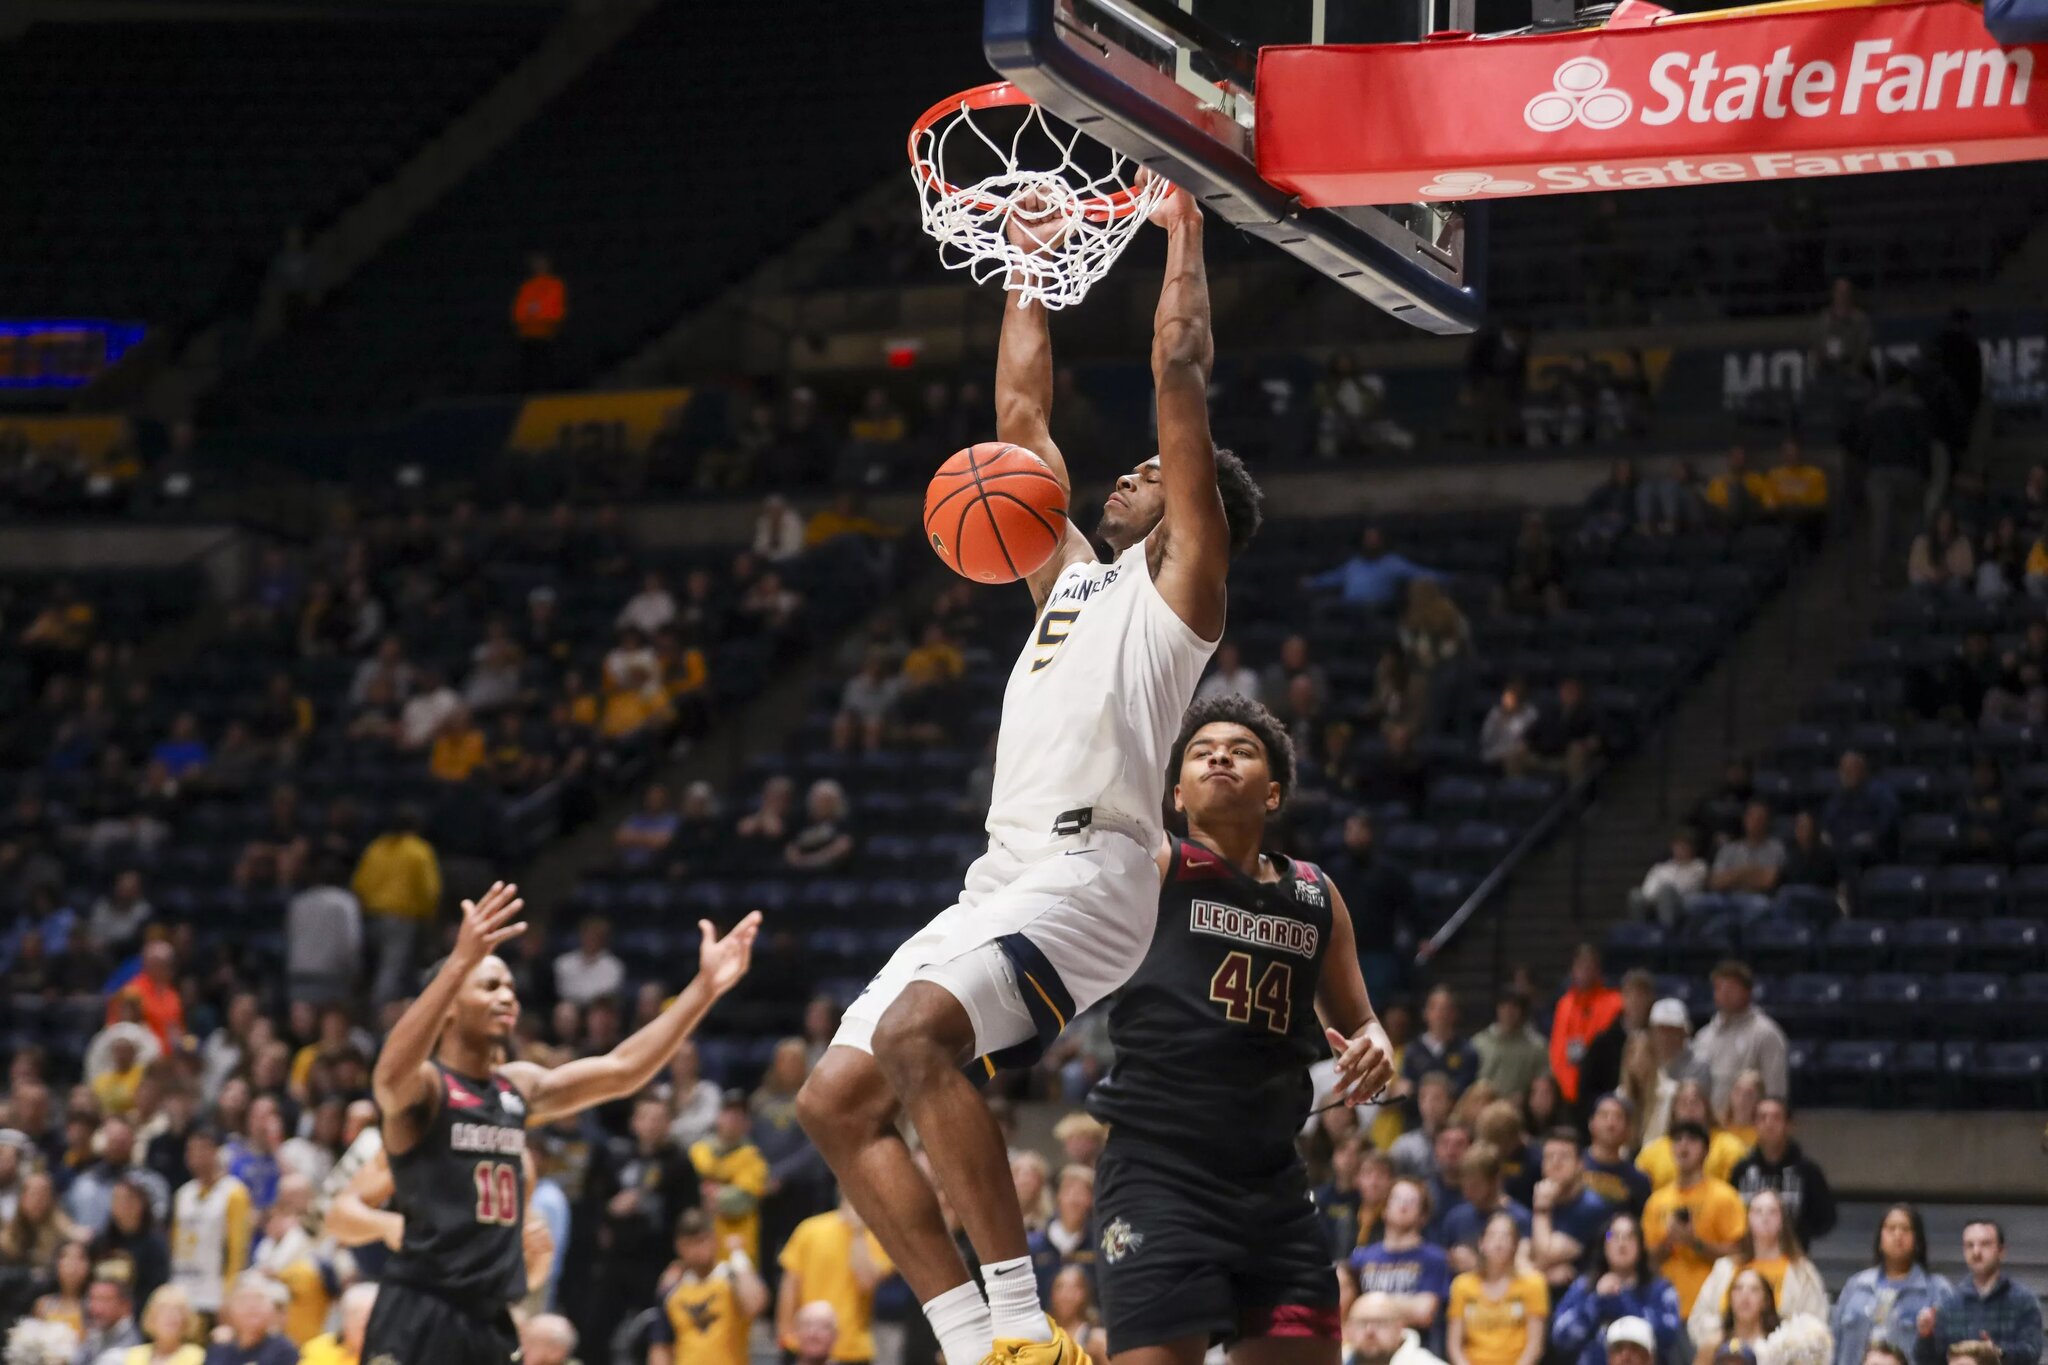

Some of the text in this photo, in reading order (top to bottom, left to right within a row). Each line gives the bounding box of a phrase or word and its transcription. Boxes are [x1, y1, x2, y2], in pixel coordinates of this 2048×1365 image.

[1190, 899, 1319, 960] LEOPARDS
[1209, 950, 1292, 1035] 44
[473, 1160, 518, 1226] 10
